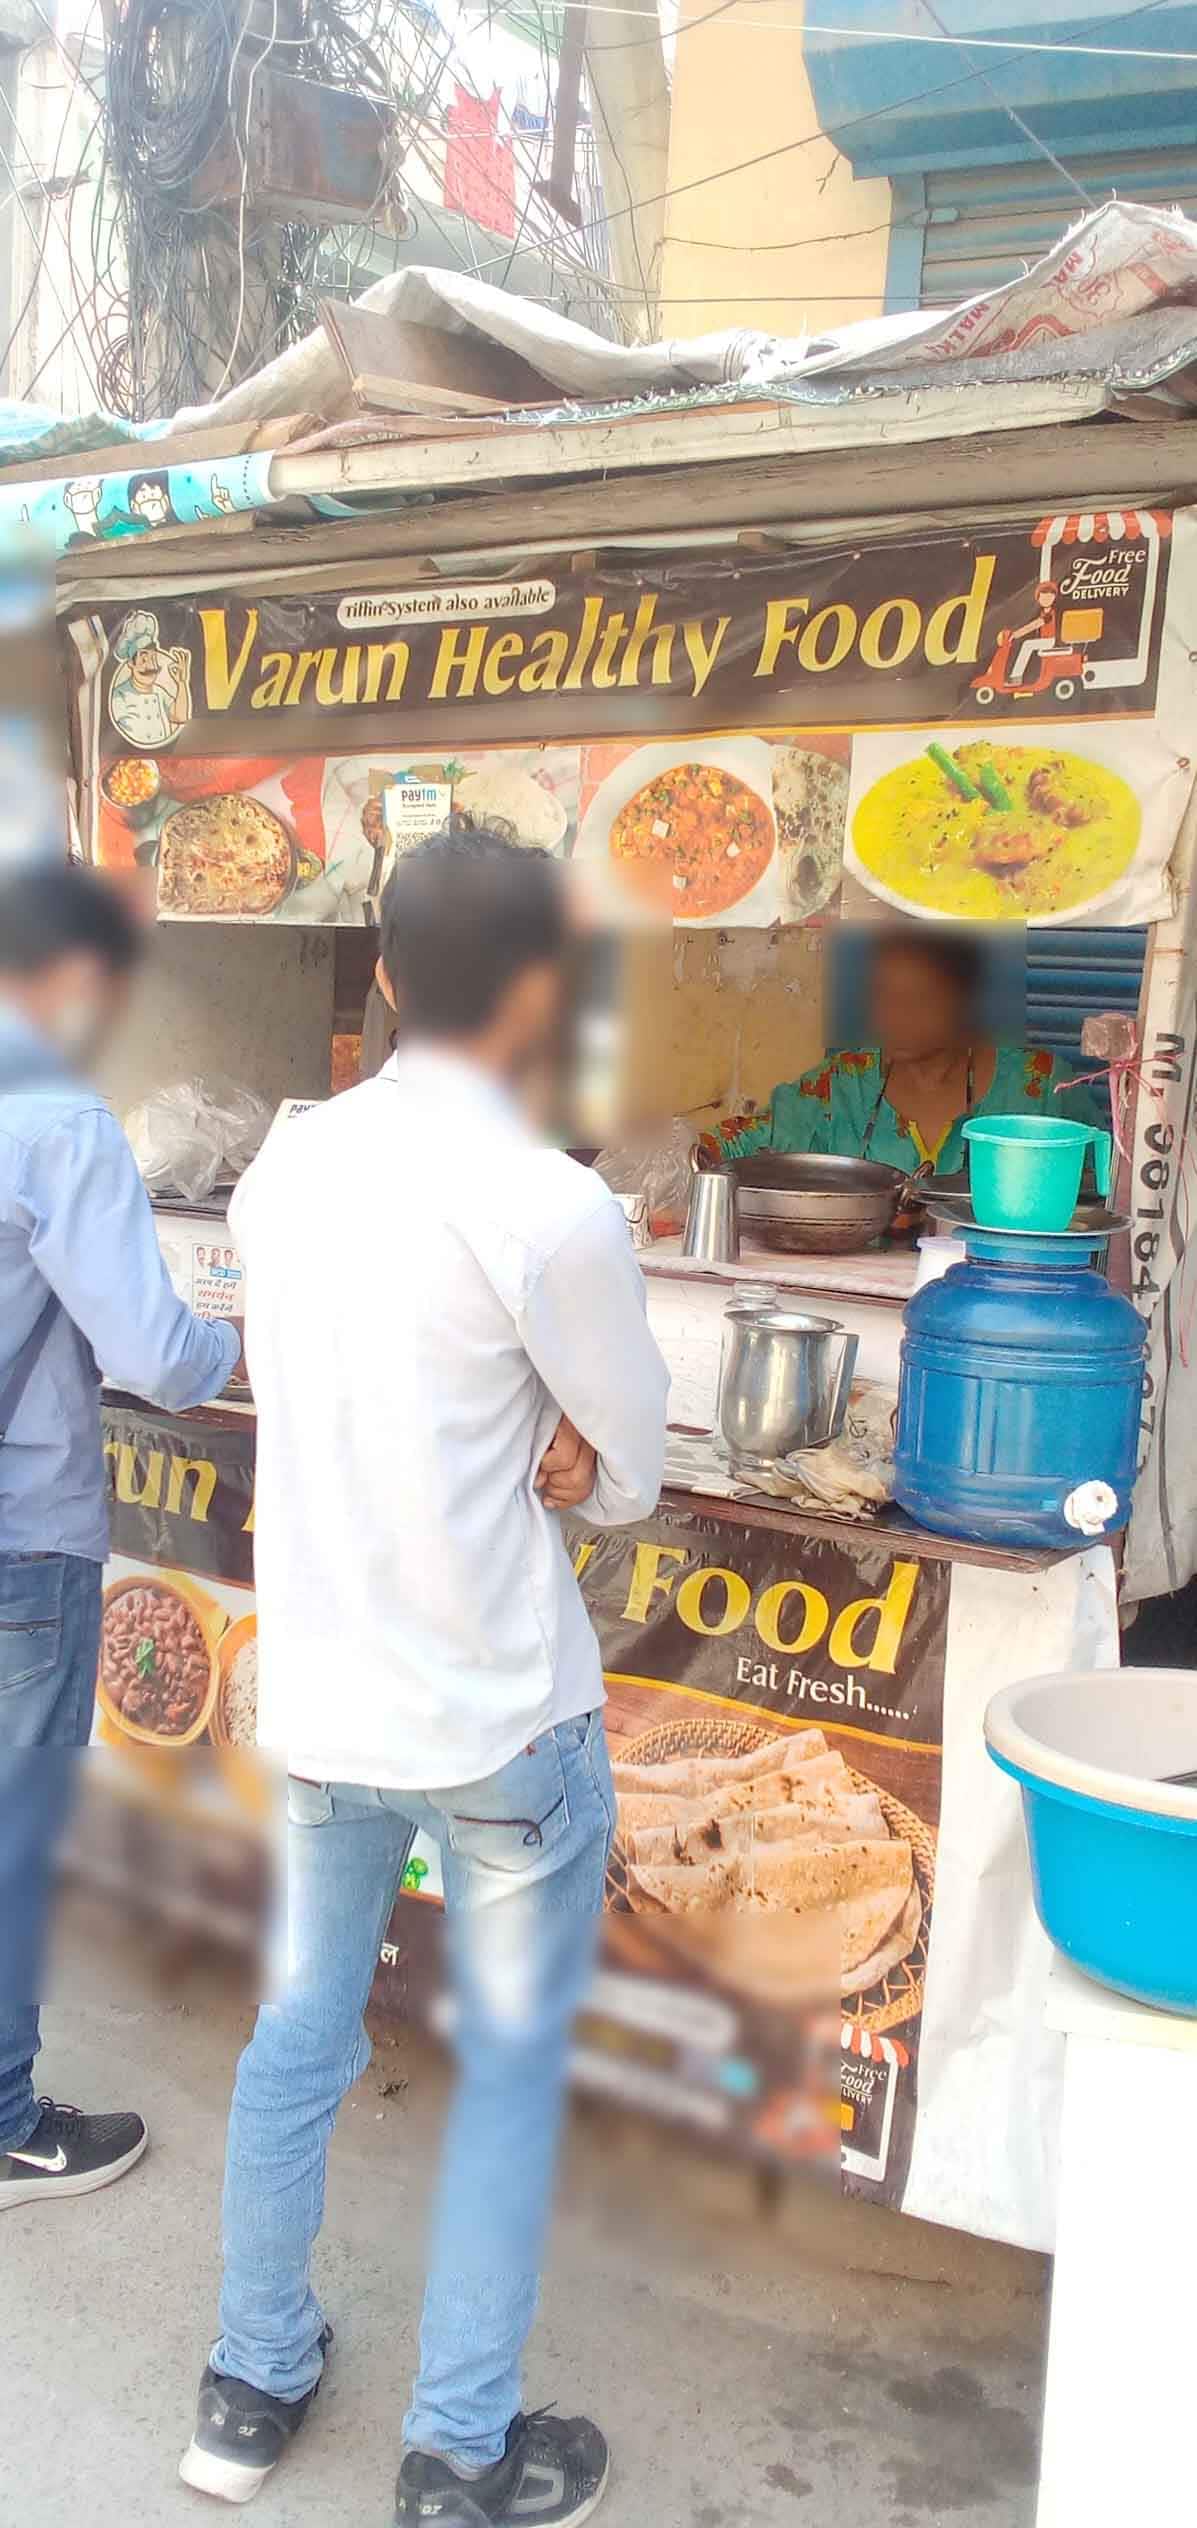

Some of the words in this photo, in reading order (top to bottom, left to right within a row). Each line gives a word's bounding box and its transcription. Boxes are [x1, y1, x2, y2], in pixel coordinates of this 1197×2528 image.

[1108, 549, 1146, 564] Free
[1060, 555, 1133, 595] Food
[386, 597, 441, 621] System
[445, 592, 479, 611] also
[483, 586, 550, 607] available
[1072, 587, 1130, 600] DELIVERY
[199, 608, 411, 711] Varun
[427, 592, 732, 698] Healthy
[753, 554, 998, 678] Food
[620, 1541, 921, 1675] Food
[736, 1656, 779, 1690] Eat
